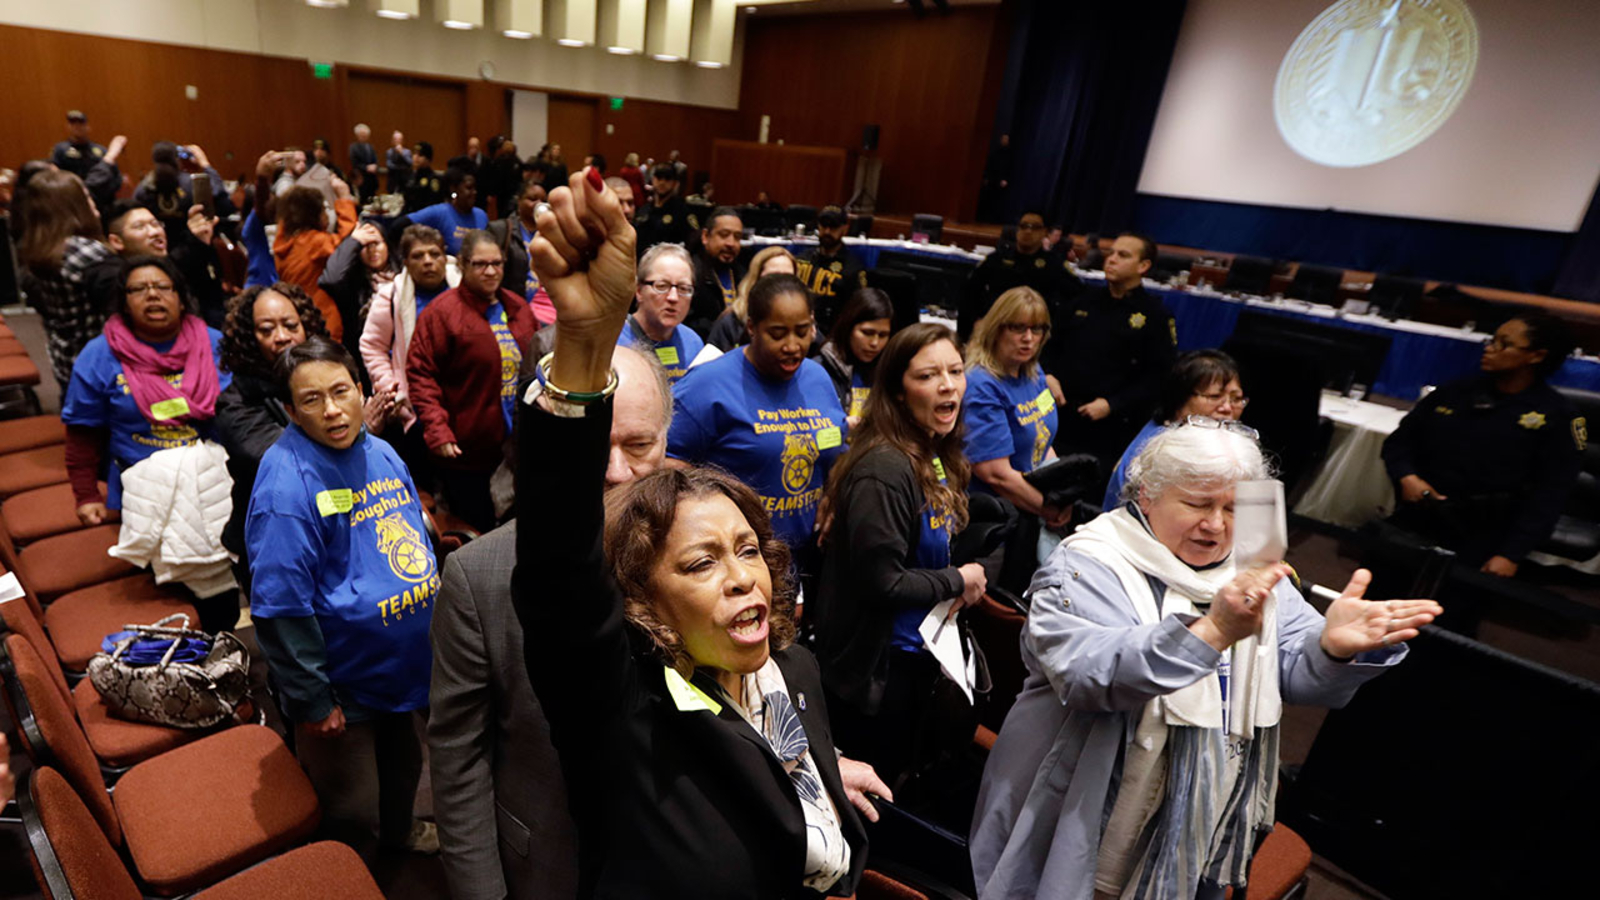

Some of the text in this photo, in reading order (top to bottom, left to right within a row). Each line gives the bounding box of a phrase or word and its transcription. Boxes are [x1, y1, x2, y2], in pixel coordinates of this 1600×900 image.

[758, 407, 821, 421] Pay Workers
[754, 417, 835, 435] Enough to LIVE
[352, 488, 367, 504] ay
[366, 477, 404, 496] Wrke
[396, 489, 412, 505] LI
[377, 573, 441, 618] TEAMS
[382, 597, 435, 628] LOCA
